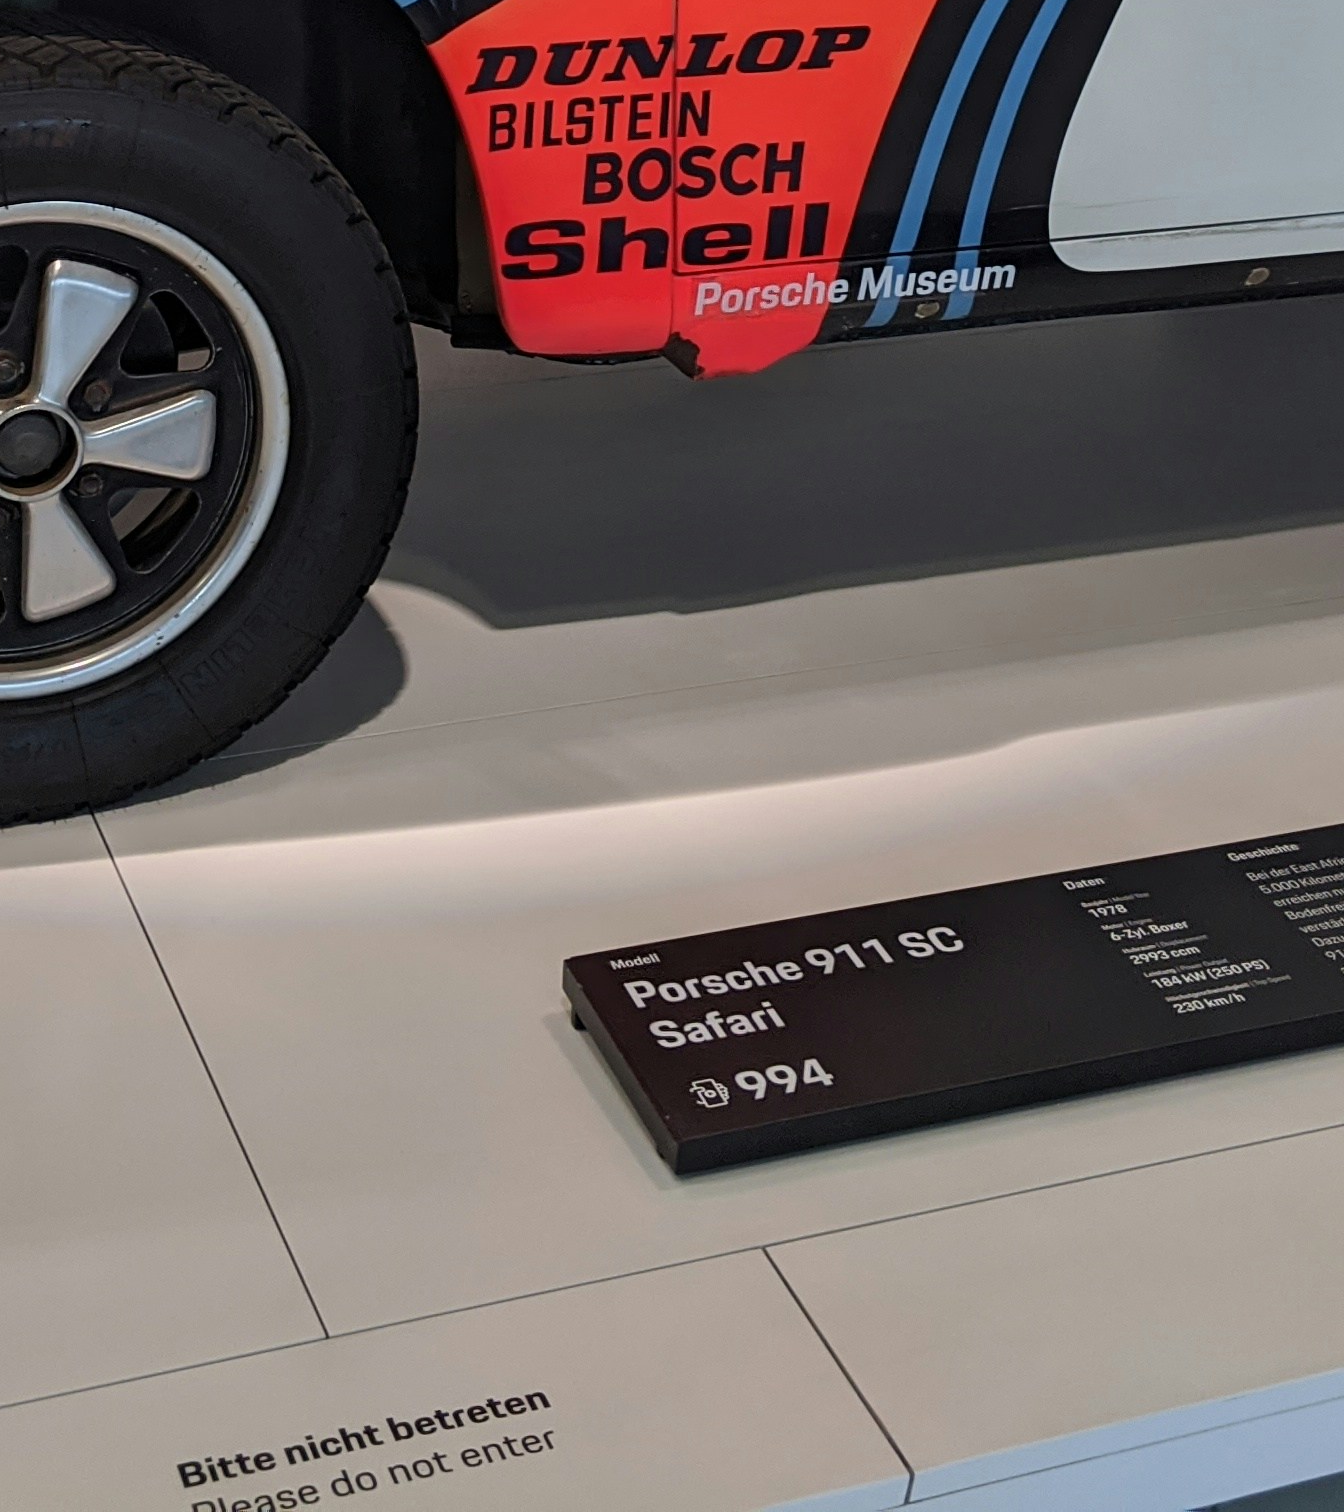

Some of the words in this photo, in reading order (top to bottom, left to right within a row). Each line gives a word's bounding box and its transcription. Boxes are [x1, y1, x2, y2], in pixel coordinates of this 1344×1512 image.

[465, 25, 871, 95] DUNLOP
[488, 90, 711, 152] BILSTEIN
[583, 141, 805, 205] BOSCH
[501, 202, 829, 280] Shell
[694, 273, 850, 317] Porsche
[856, 264, 1017, 302] Museum
[1227, 844, 1299, 862] Geschichte
[1062, 877, 1105, 890] Daten
[1245, 872, 1270, 882] Bei
[1269, 868, 1291, 878] der
[1289, 862, 1321, 874] East
[1258, 879, 1301, 894] 5.000
[1088, 904, 1128, 918] 1978
[1273, 891, 1333, 907] erreichen
[1110, 927, 1150, 941] 6-Zyl.
[1148, 921, 1188, 934] Boxer
[609, 953, 660, 970] Modell
[625, 961, 802, 1007] Porsche
[805, 939, 893, 974] 911
[898, 927, 964, 958] SC
[1129, 950, 1170, 965] 2993
[1170, 946, 1201, 958] ccm
[1151, 975, 1183, 988] 184
[1180, 970, 1207, 983] kW
[1206, 964, 1243, 980] (250
[1240, 959, 1270, 972] PS)
[1172, 999, 1205, 1014] 230
[1203, 993, 1246, 1008] km/h
[650, 1002, 784, 1048] Safari
[735, 1059, 833, 1099] 994
[176, 1451, 277, 1489] Bitte
[284, 1424, 384, 1466] nicht
[386, 1391, 552, 1441] betreten
[330, 1469, 378, 1497] do
[387, 1451, 453, 1485] not
[460, 1429, 557, 1468] enter
